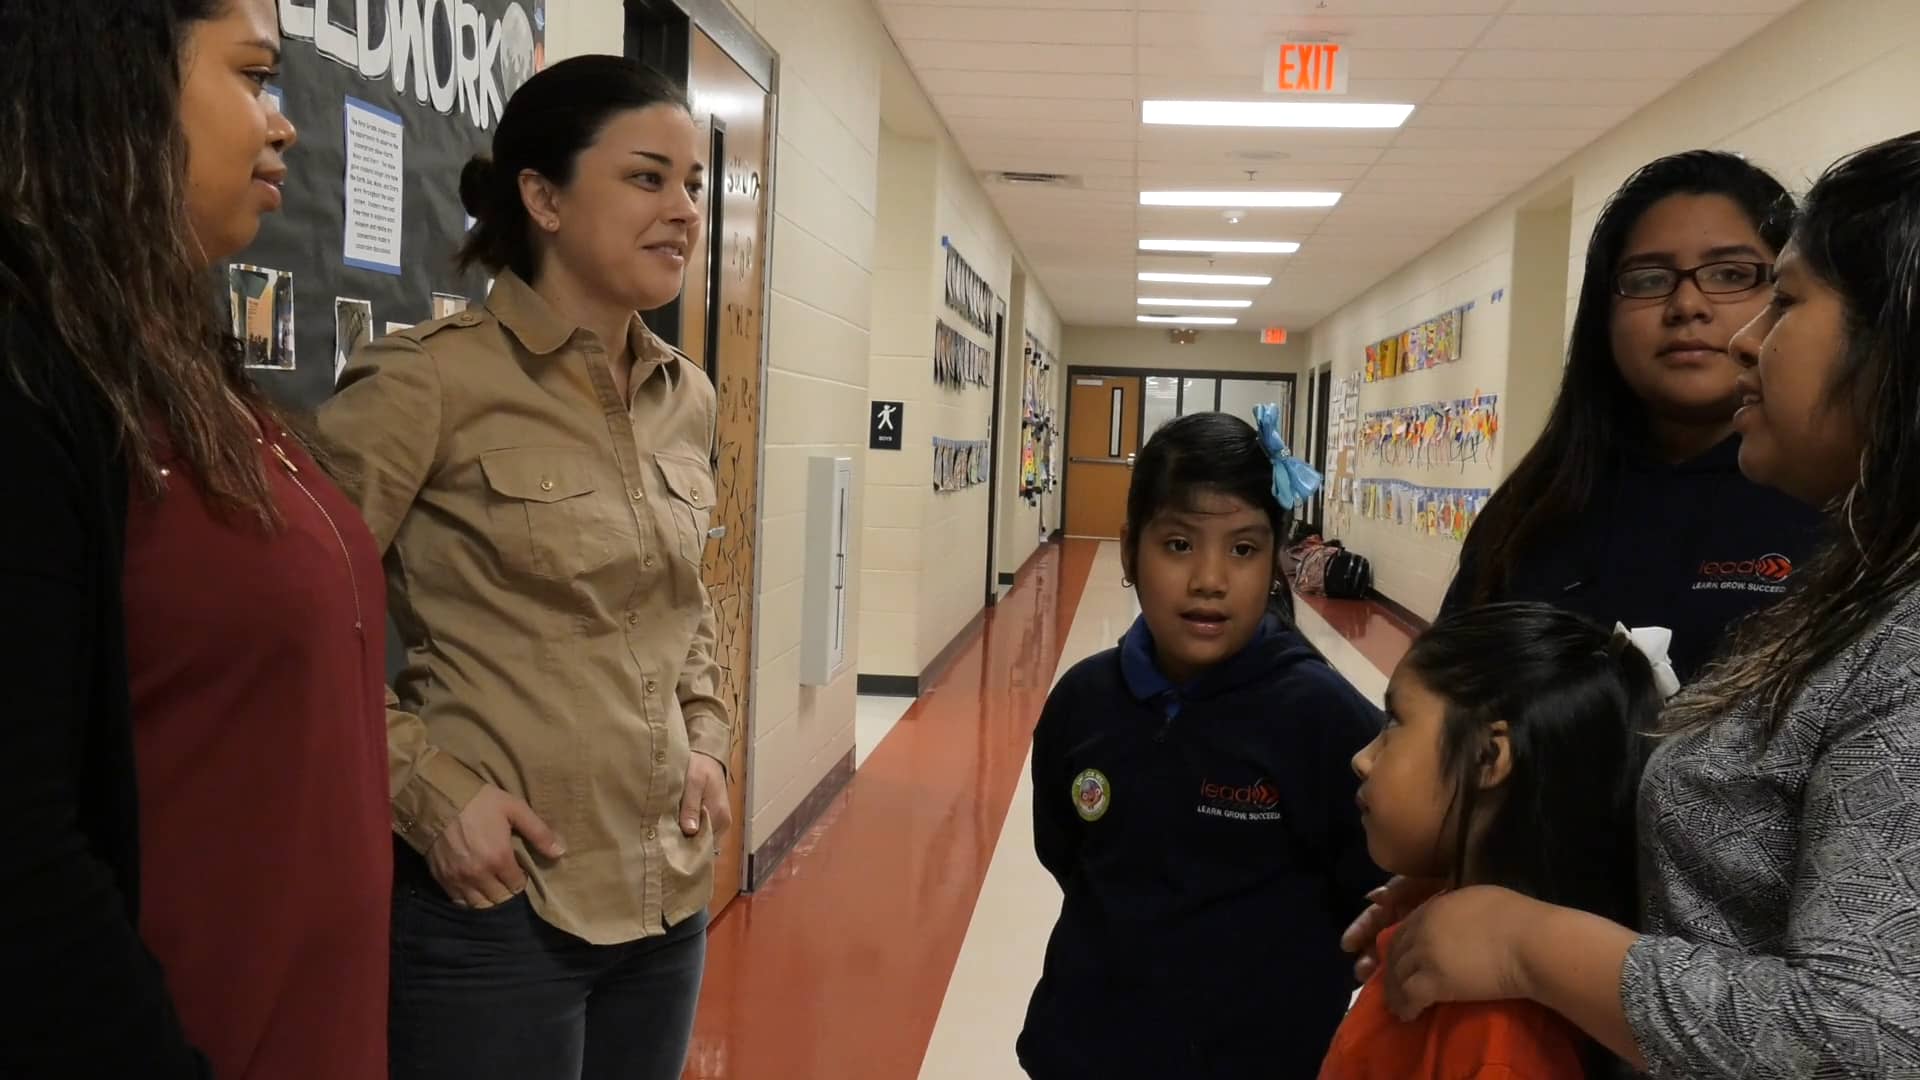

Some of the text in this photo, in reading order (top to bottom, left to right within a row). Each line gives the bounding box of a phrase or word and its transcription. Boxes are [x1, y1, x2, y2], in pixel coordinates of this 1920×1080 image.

[1279, 44, 1339, 91] EXIT
[1697, 559, 1755, 576] lead
[1201, 778, 1251, 802] lead
